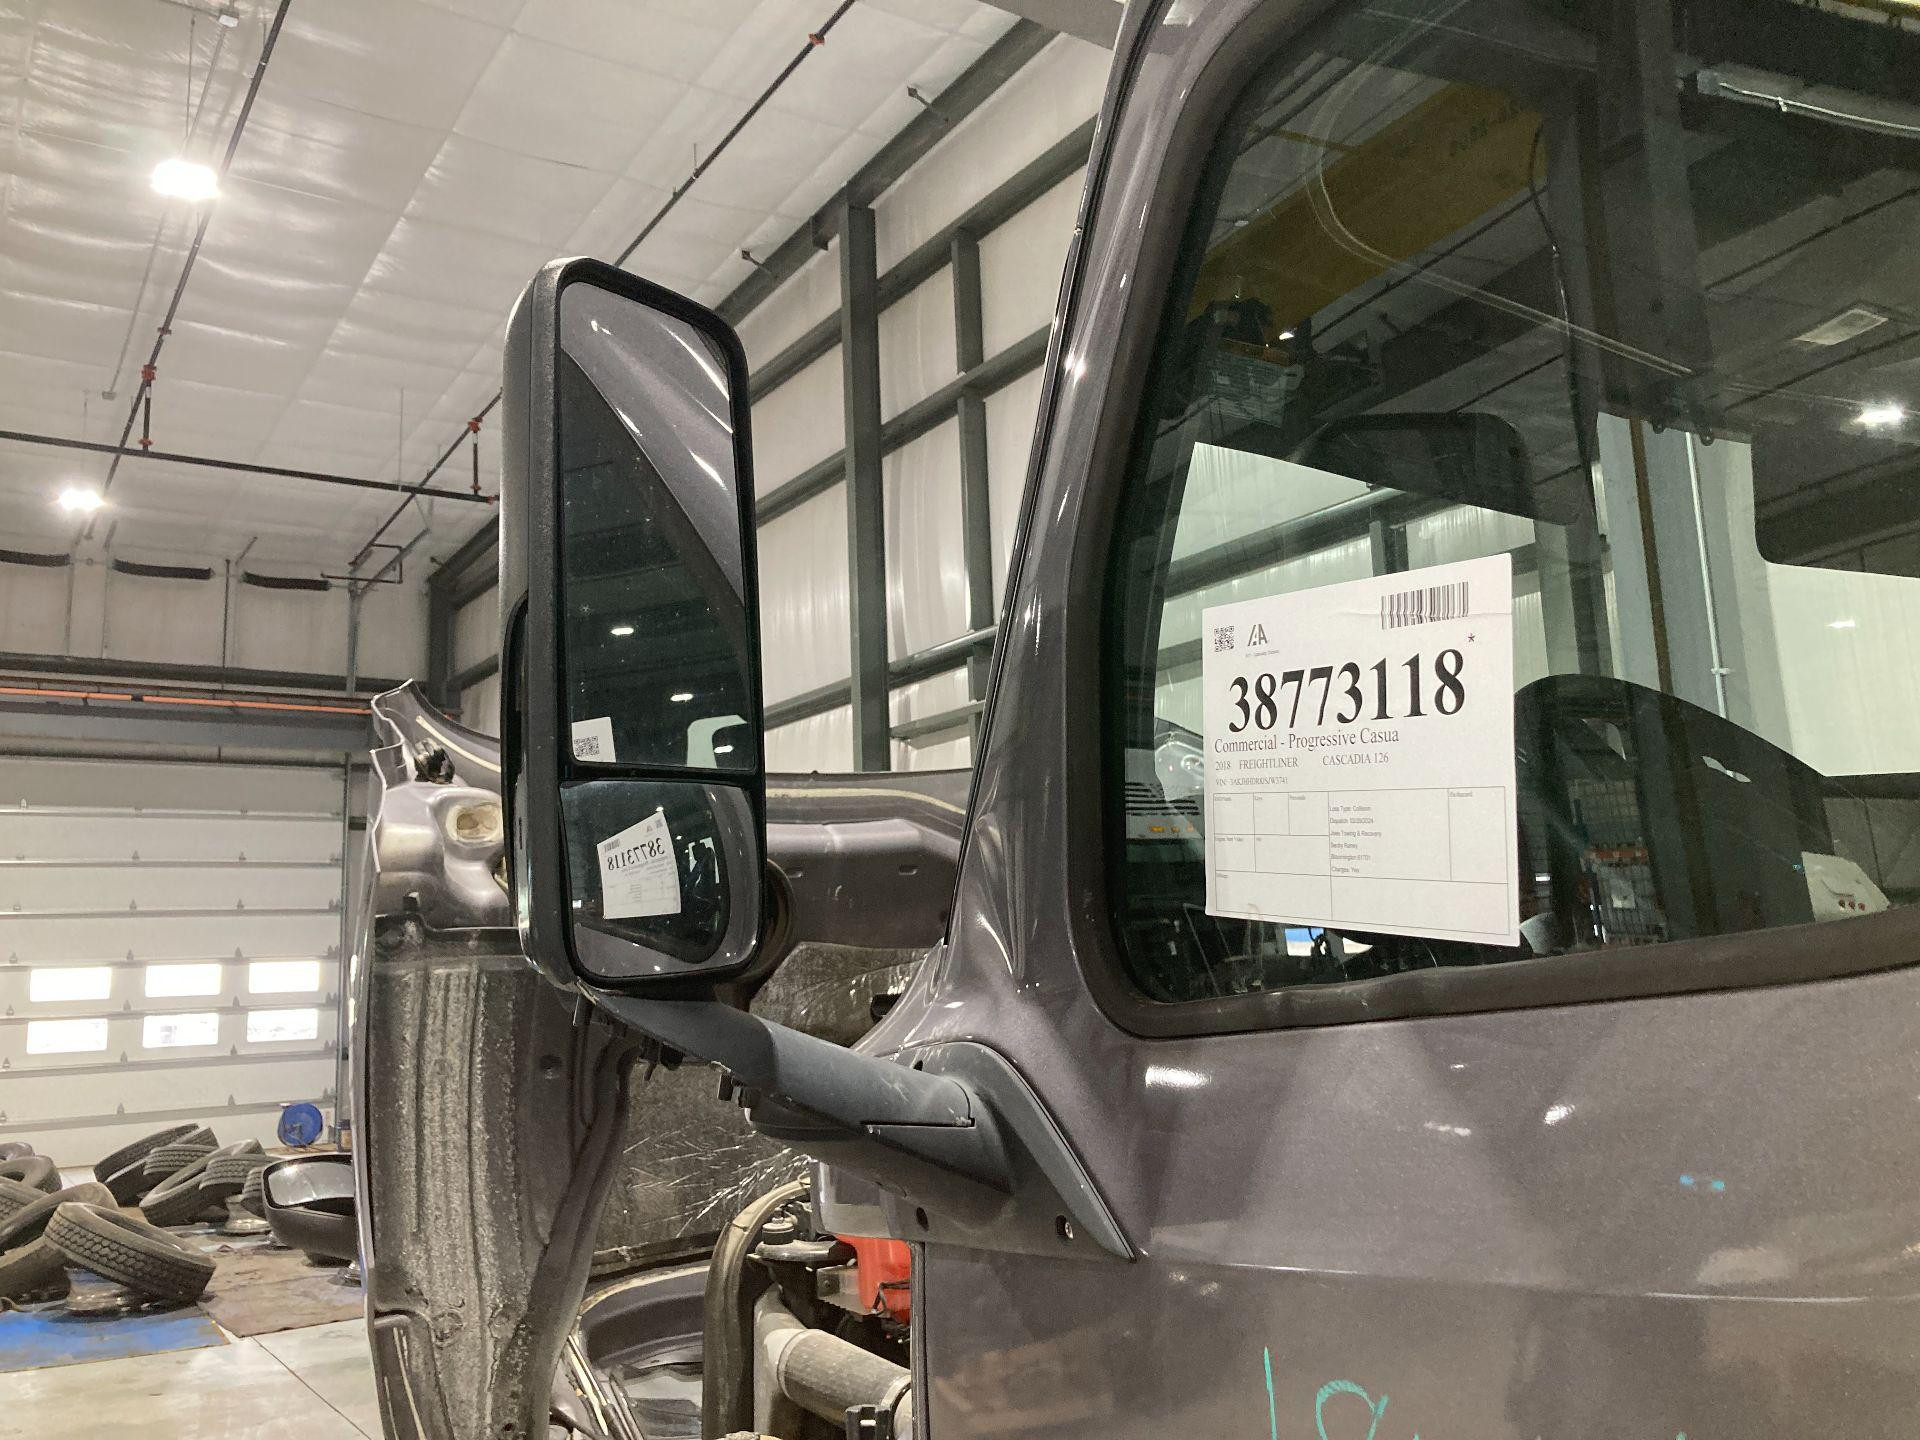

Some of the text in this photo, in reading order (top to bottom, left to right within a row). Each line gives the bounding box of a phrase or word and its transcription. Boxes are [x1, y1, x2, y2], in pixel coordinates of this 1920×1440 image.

[1229, 648, 1465, 732] 38773118
[1215, 735, 1277, 753] Commercial
[1289, 730, 1356, 751] Progressive
[1360, 727, 1399, 744] Casua
[1215, 752, 1389, 771] 2018 FREIGHTLINER CASCADIA 126
